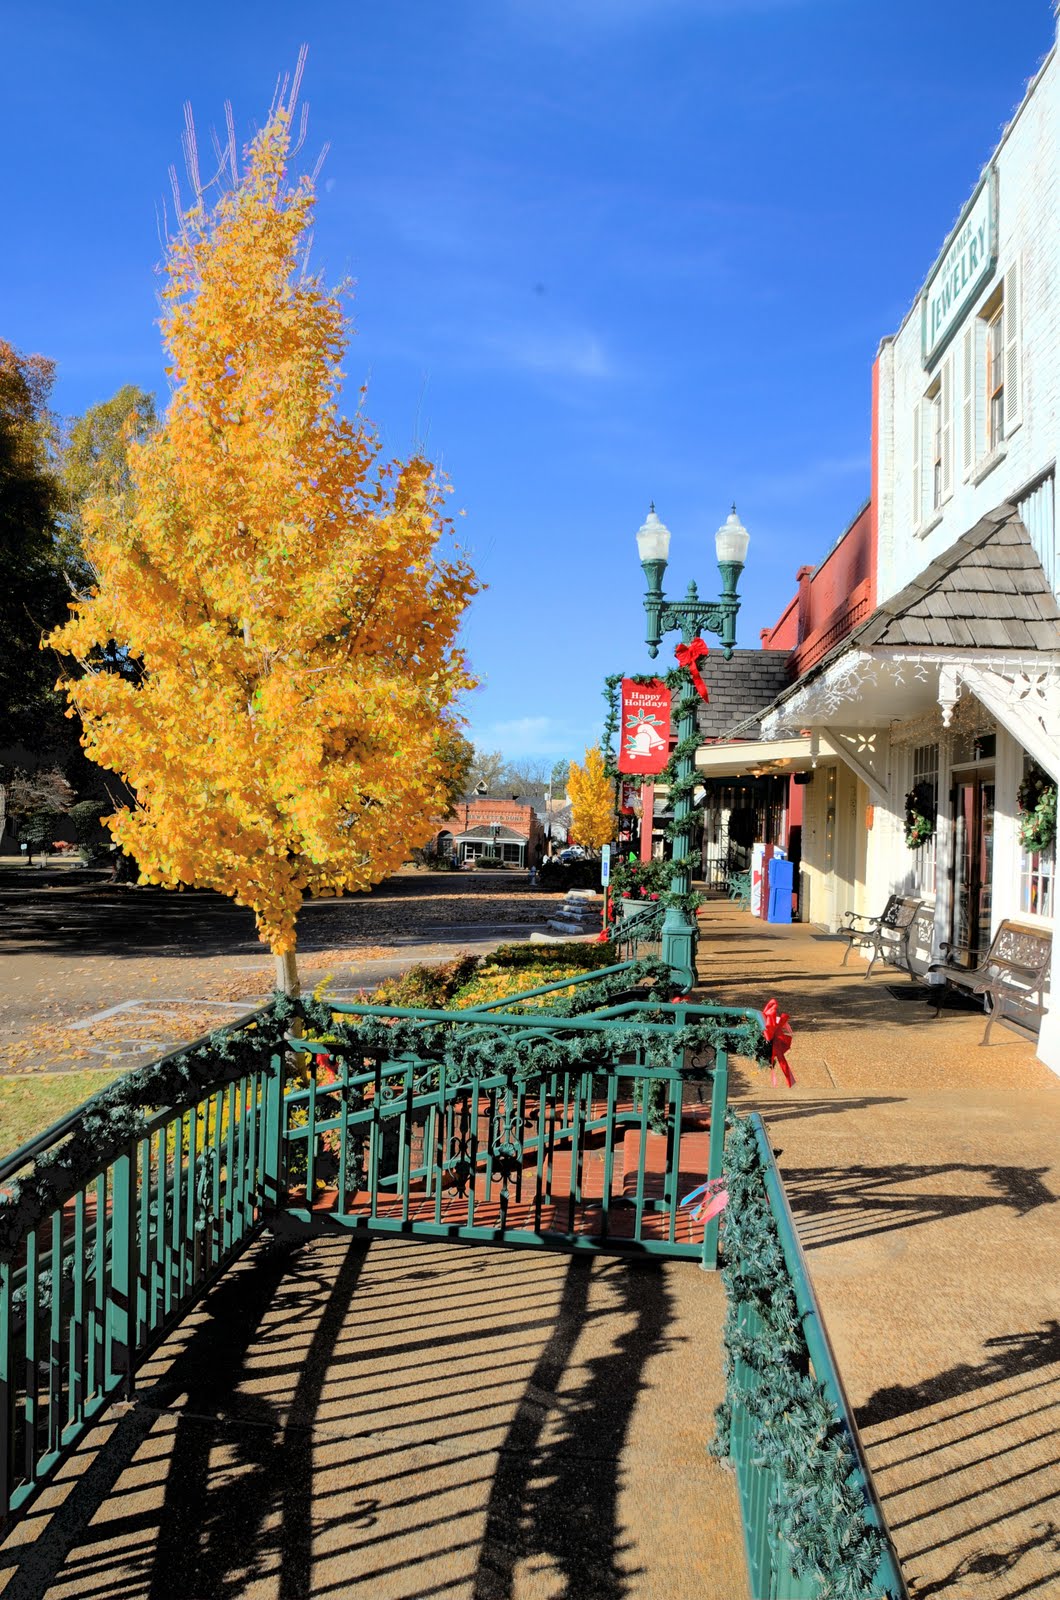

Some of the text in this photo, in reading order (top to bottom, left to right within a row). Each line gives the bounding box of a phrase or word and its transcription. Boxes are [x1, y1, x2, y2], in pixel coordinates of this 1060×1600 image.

[931, 216, 987, 350] JEWELRY
[631, 692, 661, 700] Happy
[624, 699, 668, 708] Holidays
